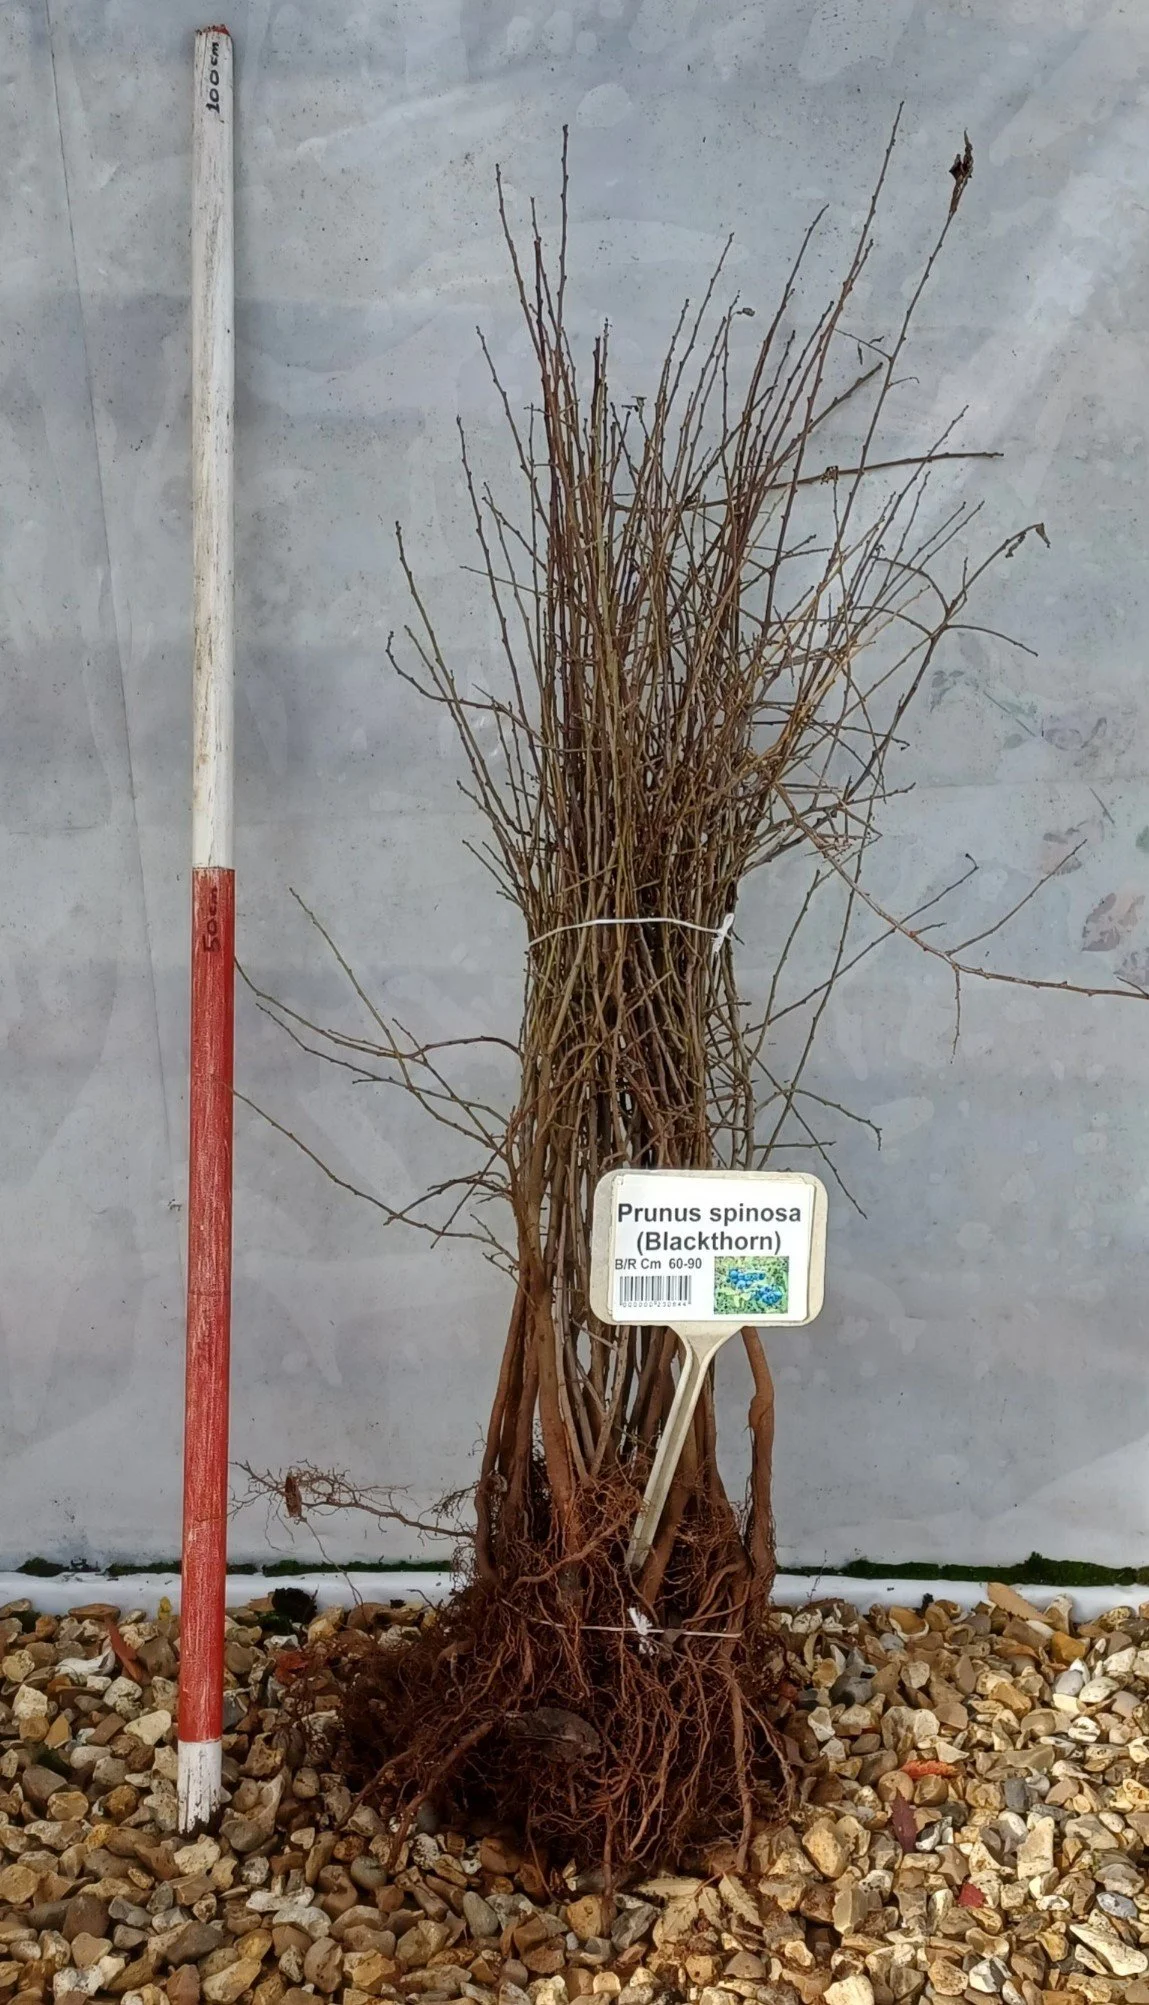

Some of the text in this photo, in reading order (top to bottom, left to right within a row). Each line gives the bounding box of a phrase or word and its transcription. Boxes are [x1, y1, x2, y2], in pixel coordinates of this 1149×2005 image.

[202, 886, 221, 953] 50cm
[618, 1203, 801, 1227] Prunus spinosa
[636, 1231, 781, 1256] (Blackthorn)
[614, 1257, 702, 1270] B/R Cm 60-90
